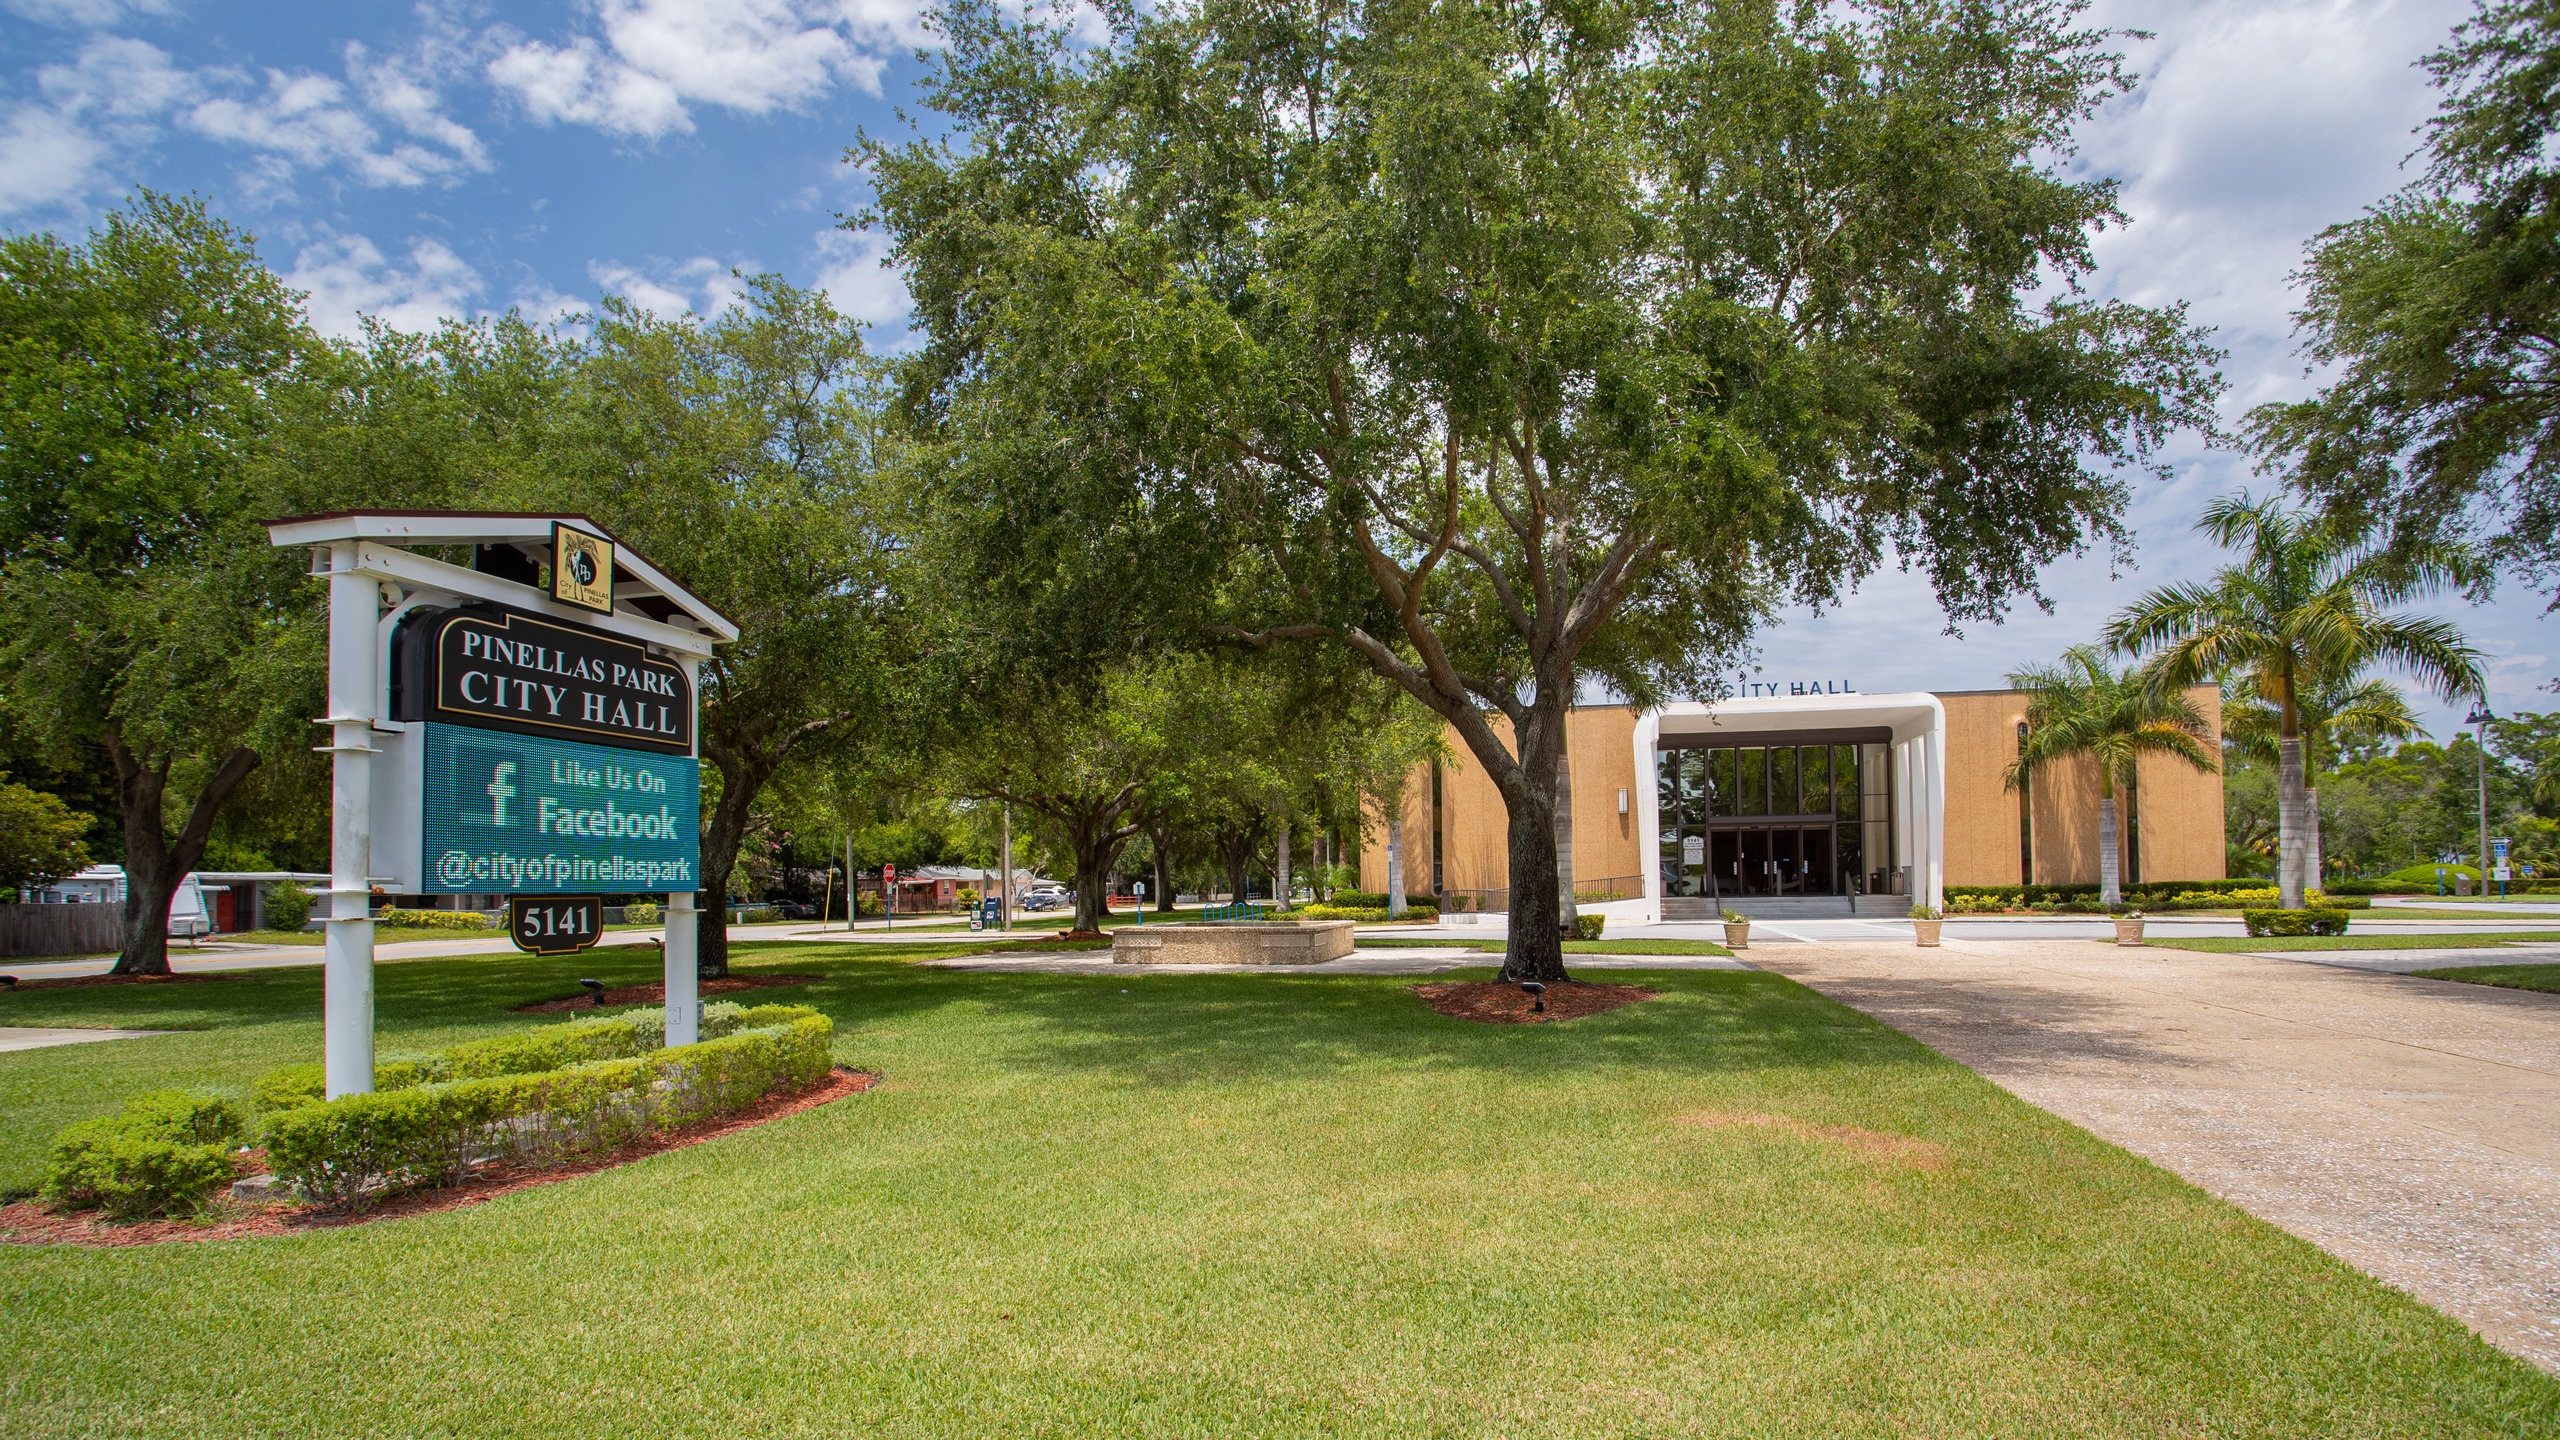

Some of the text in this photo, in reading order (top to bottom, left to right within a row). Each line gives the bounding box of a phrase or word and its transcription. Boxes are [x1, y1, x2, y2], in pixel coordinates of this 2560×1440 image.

[560, 580, 572, 590] City
[583, 587, 609, 600] PINELLAS
[589, 596, 604, 605] PARK
[462, 630, 677, 697] PINELLAS PARK
[460, 670, 678, 735] CITY HALL
[1722, 679, 1857, 698] CITY HALL
[551, 760, 667, 794] Like Us On
[538, 796, 679, 841] Facebook
[437, 850, 691, 888] @cityofpinellaspark
[884, 869, 895, 878] STOP
[524, 907, 591, 938] 5141
